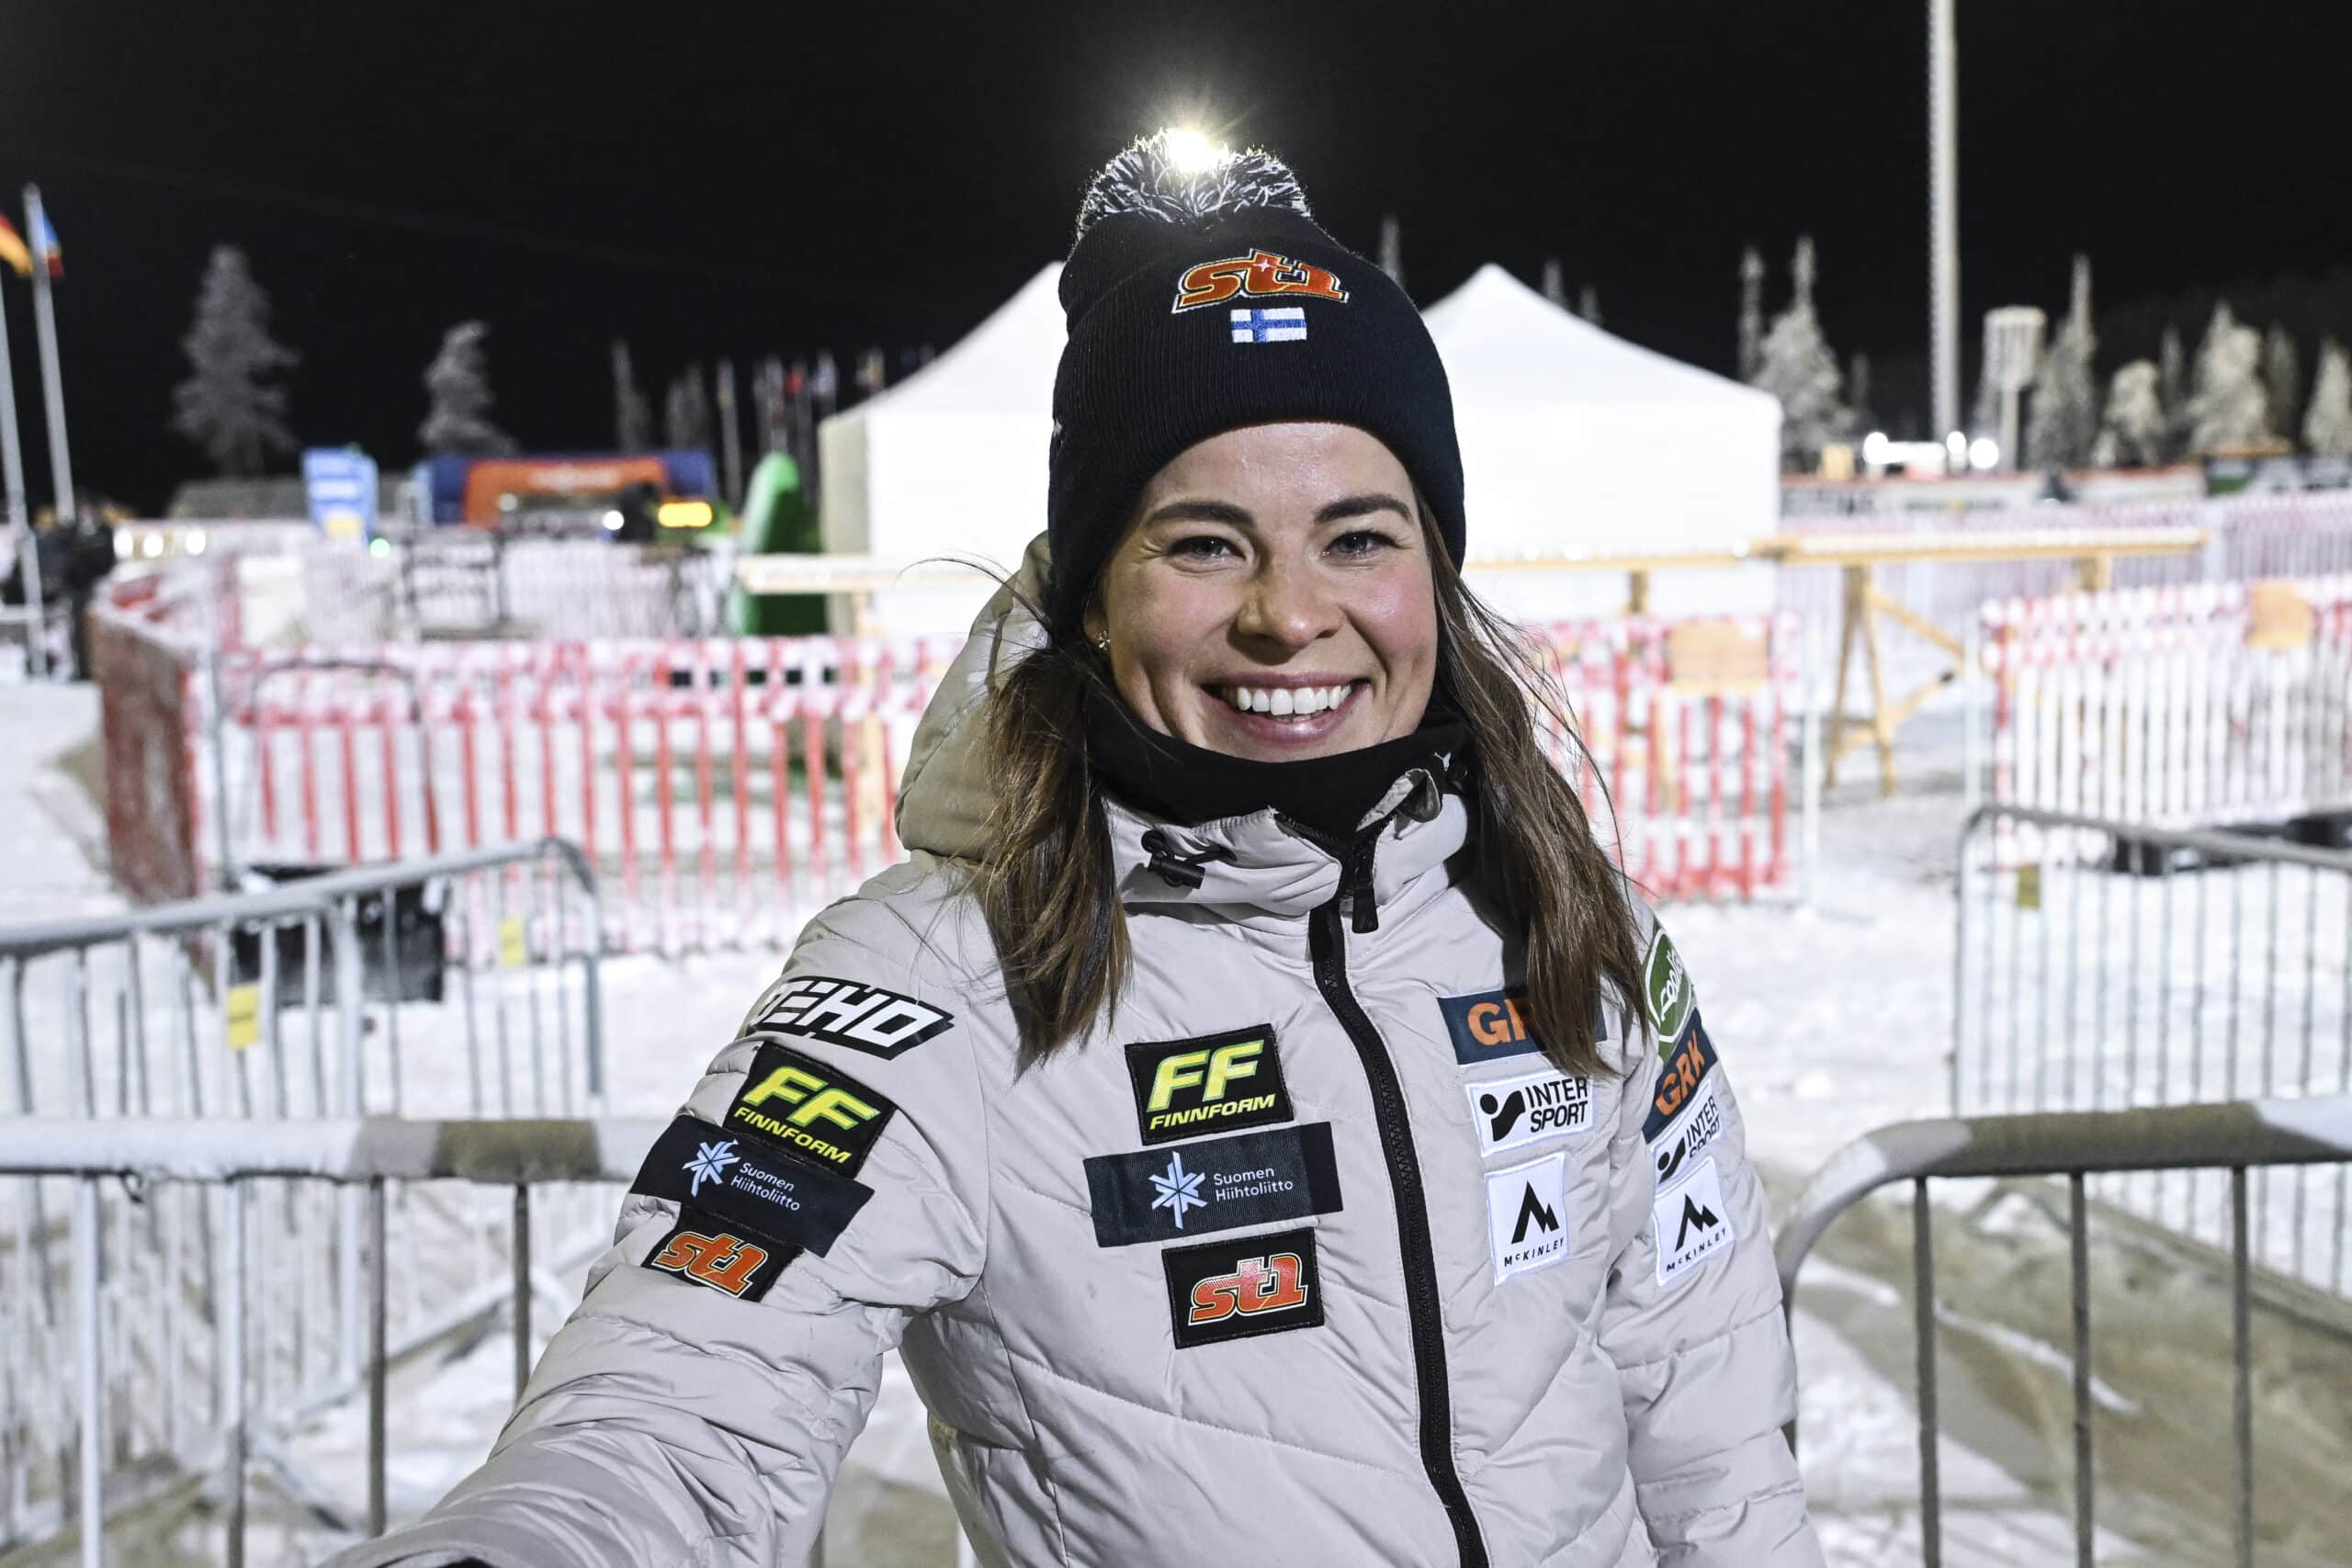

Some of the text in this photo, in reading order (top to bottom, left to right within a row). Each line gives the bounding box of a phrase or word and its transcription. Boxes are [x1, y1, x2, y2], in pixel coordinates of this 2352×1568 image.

[1147, 1039, 1264, 1112] FF
[1656, 1029, 1705, 1116] GRK
[741, 1065, 882, 1131] FF
[1525, 1077, 1589, 1109] INTER
[1530, 1100, 1589, 1134] SPORT
[1687, 1095, 1718, 1147] INTER
[730, 1174, 801, 1213] Hiihtoliitto
[739, 1162, 795, 1191] Suomen
[1214, 1168, 1275, 1187] Suomen
[1215, 1178, 1294, 1202] Hiihtoliitto
